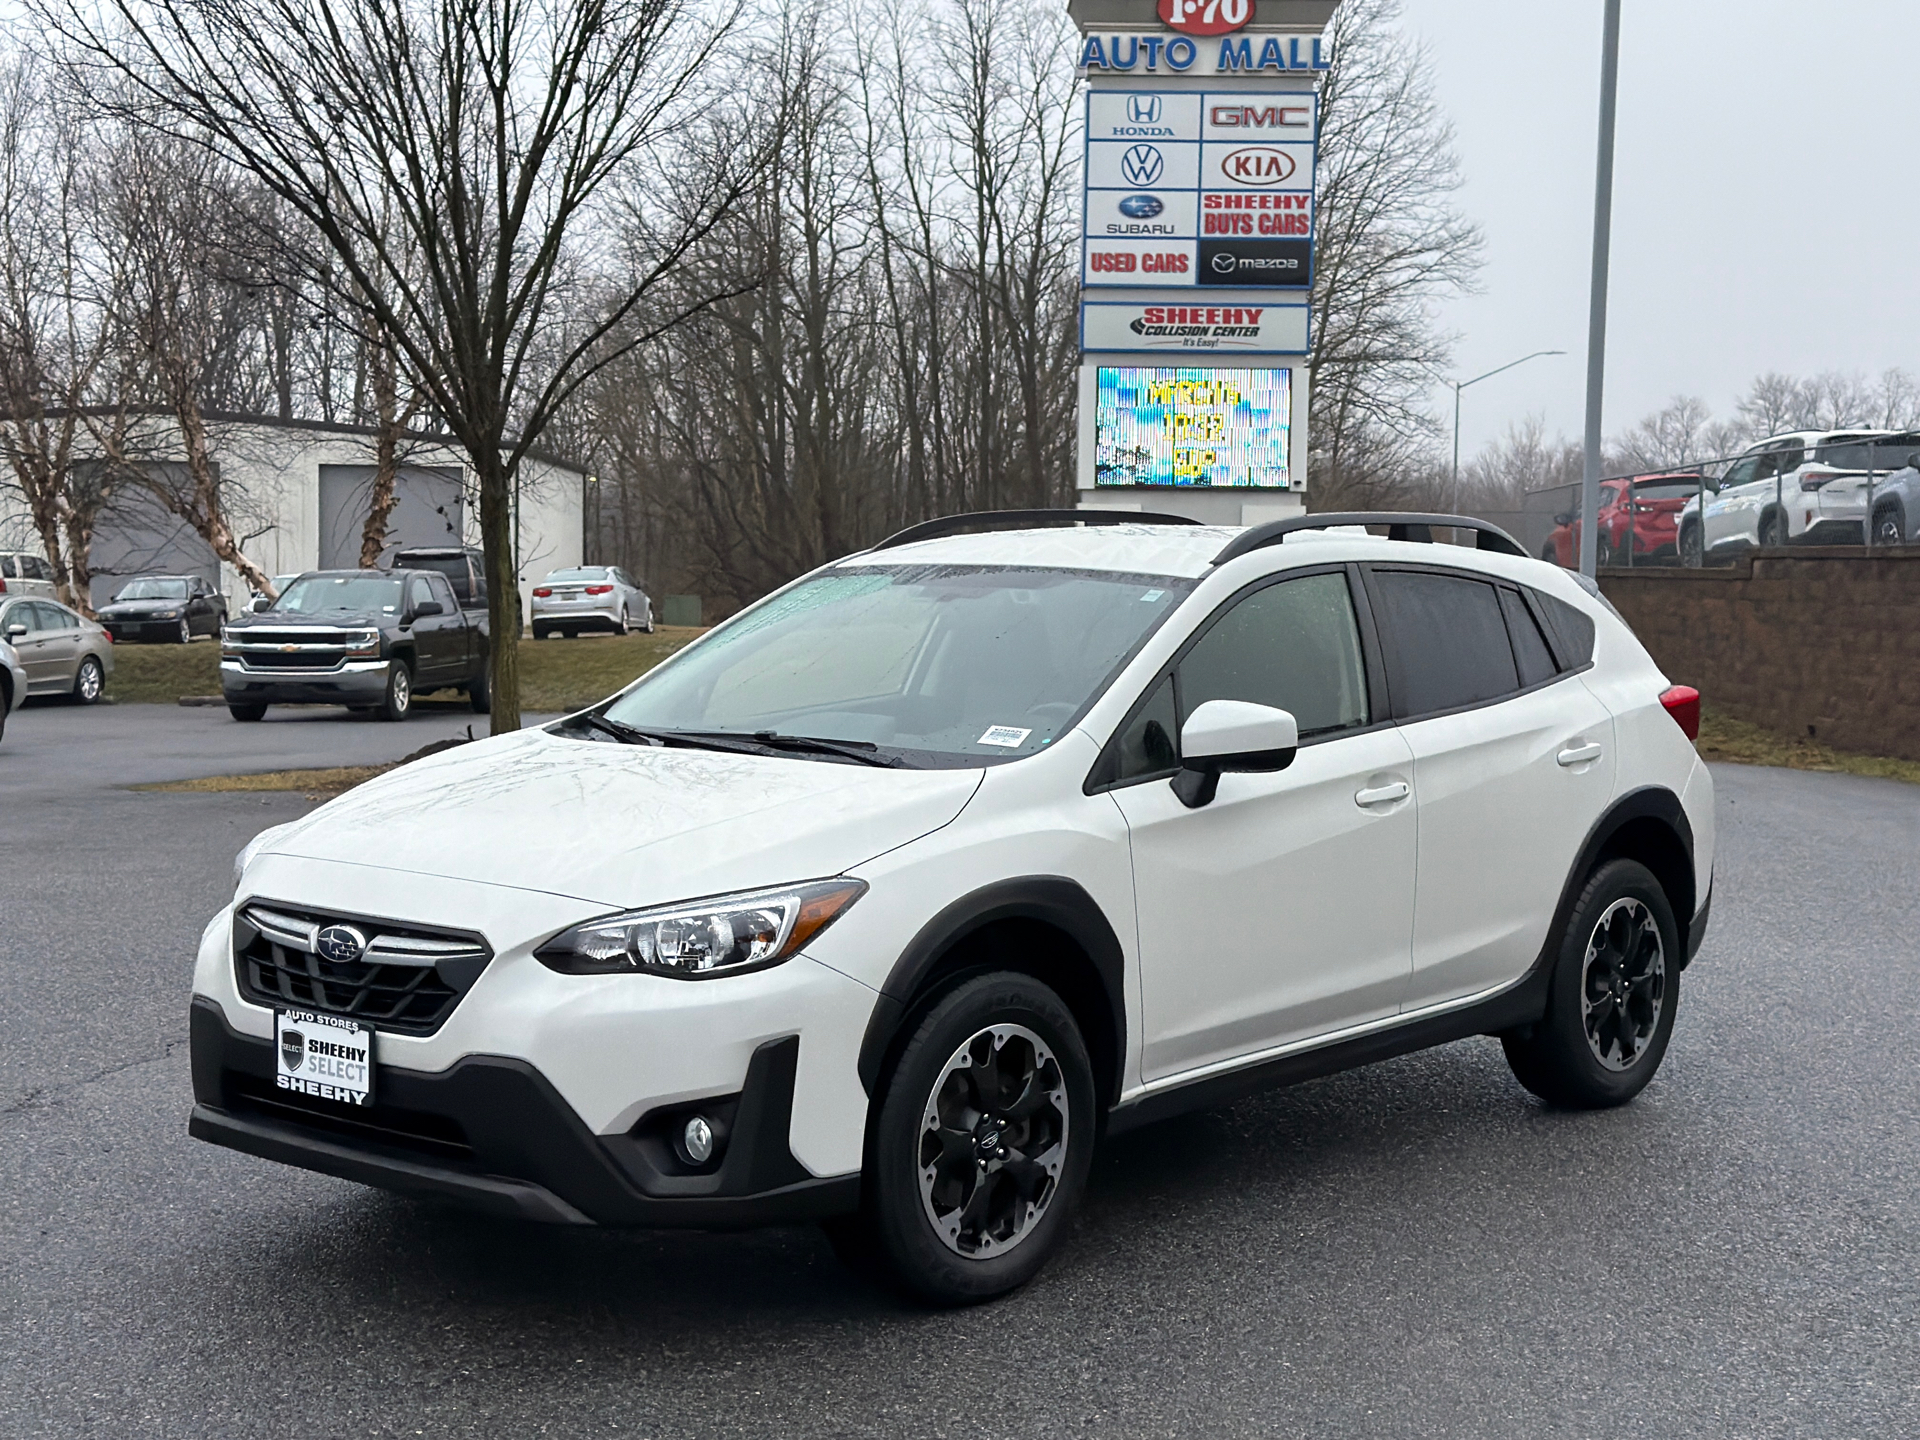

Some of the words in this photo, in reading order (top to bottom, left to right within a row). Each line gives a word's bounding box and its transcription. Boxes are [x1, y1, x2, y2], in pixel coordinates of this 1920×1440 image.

[1079, 36, 1197, 70] AUTO
[1217, 38, 1331, 71] MALL
[1210, 105, 1309, 128] GMC
[1112, 127, 1175, 136] HONDA
[1235, 157, 1283, 176] KIA
[1204, 195, 1309, 209] SHEEHY
[1106, 223, 1174, 234] SUBARU
[1204, 213, 1253, 235] BUYS
[1258, 213, 1309, 235] CARS
[1091, 252, 1137, 272] USED
[1142, 253, 1189, 273] CARS
[1144, 308, 1263, 324] SHEEHY
[1145, 325, 1208, 336] COLLISION
[1212, 326, 1260, 337] CENTER
[1182, 338, 1196, 347] It's
[1196, 338, 1219, 348] Easy!
[285, 1009, 314, 1022] AUTO
[316, 1015, 359, 1032] STORES
[308, 1038, 366, 1063] SHEEHY
[308, 1055, 366, 1083] SELECT
[276, 1074, 367, 1106] SHEEHY
